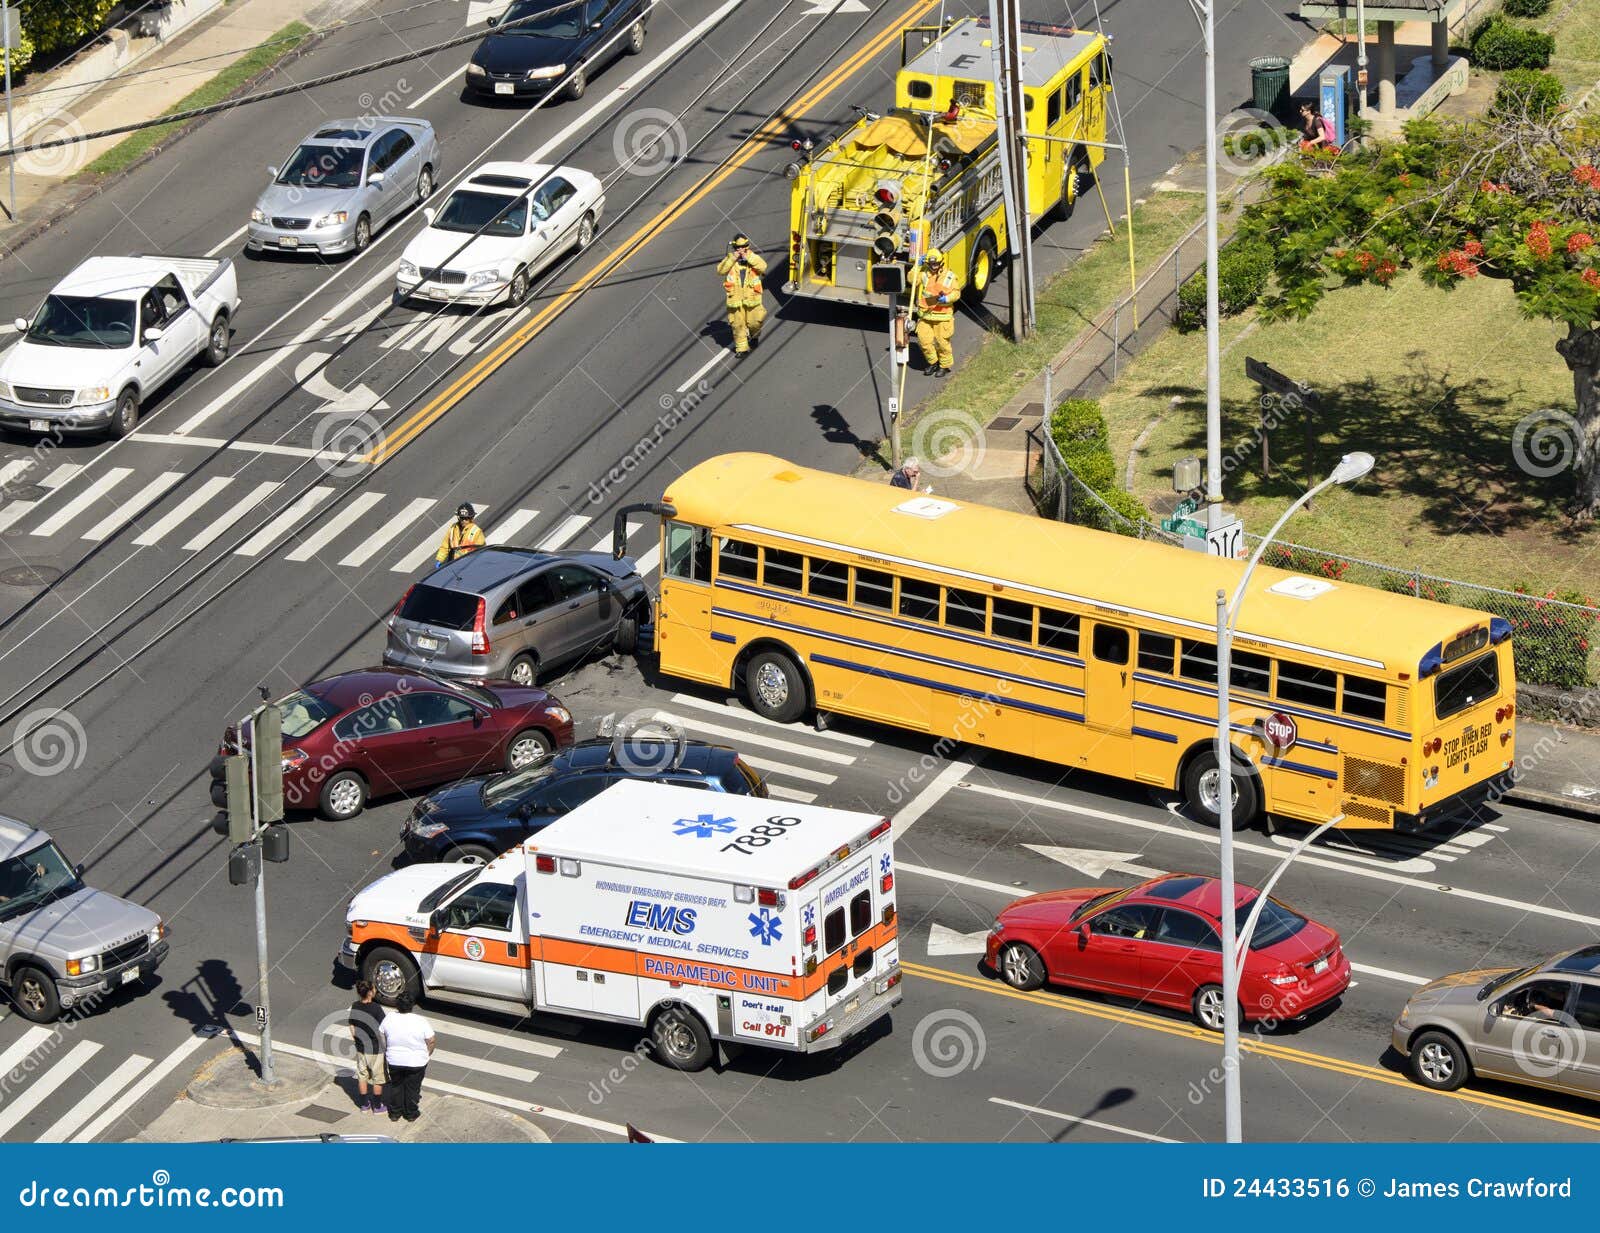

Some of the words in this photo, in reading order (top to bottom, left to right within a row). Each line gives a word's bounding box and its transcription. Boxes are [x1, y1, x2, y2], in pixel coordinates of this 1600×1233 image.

[1268, 722, 1292, 738] STOP
[1443, 736, 1460, 756] STOP
[1461, 729, 1479, 748] WHEN
[1480, 722, 1492, 740] RED
[1446, 749, 1468, 769] LIGHTS
[1468, 739, 1489, 758] FLASH
[720, 816, 802, 855] 7886
[632, 886, 673, 900] EMERGENCY
[674, 892, 707, 905] SERVICES
[824, 867, 871, 906] AMBULANCE
[625, 900, 698, 935] EMS
[124, 929, 145, 941] ROVER
[579, 925, 645, 943] EMERGENCY
[647, 935, 693, 951] MEDICAL
[696, 943, 749, 960] SERVICES
[644, 958, 737, 986] PARAMEDIC
[743, 972, 781, 993] UNIT
[742, 1000, 763, 1011] Don't
[765, 1002, 784, 1013] stall
[742, 1020, 761, 1032] Call
[764, 1022, 786, 1038] 911
